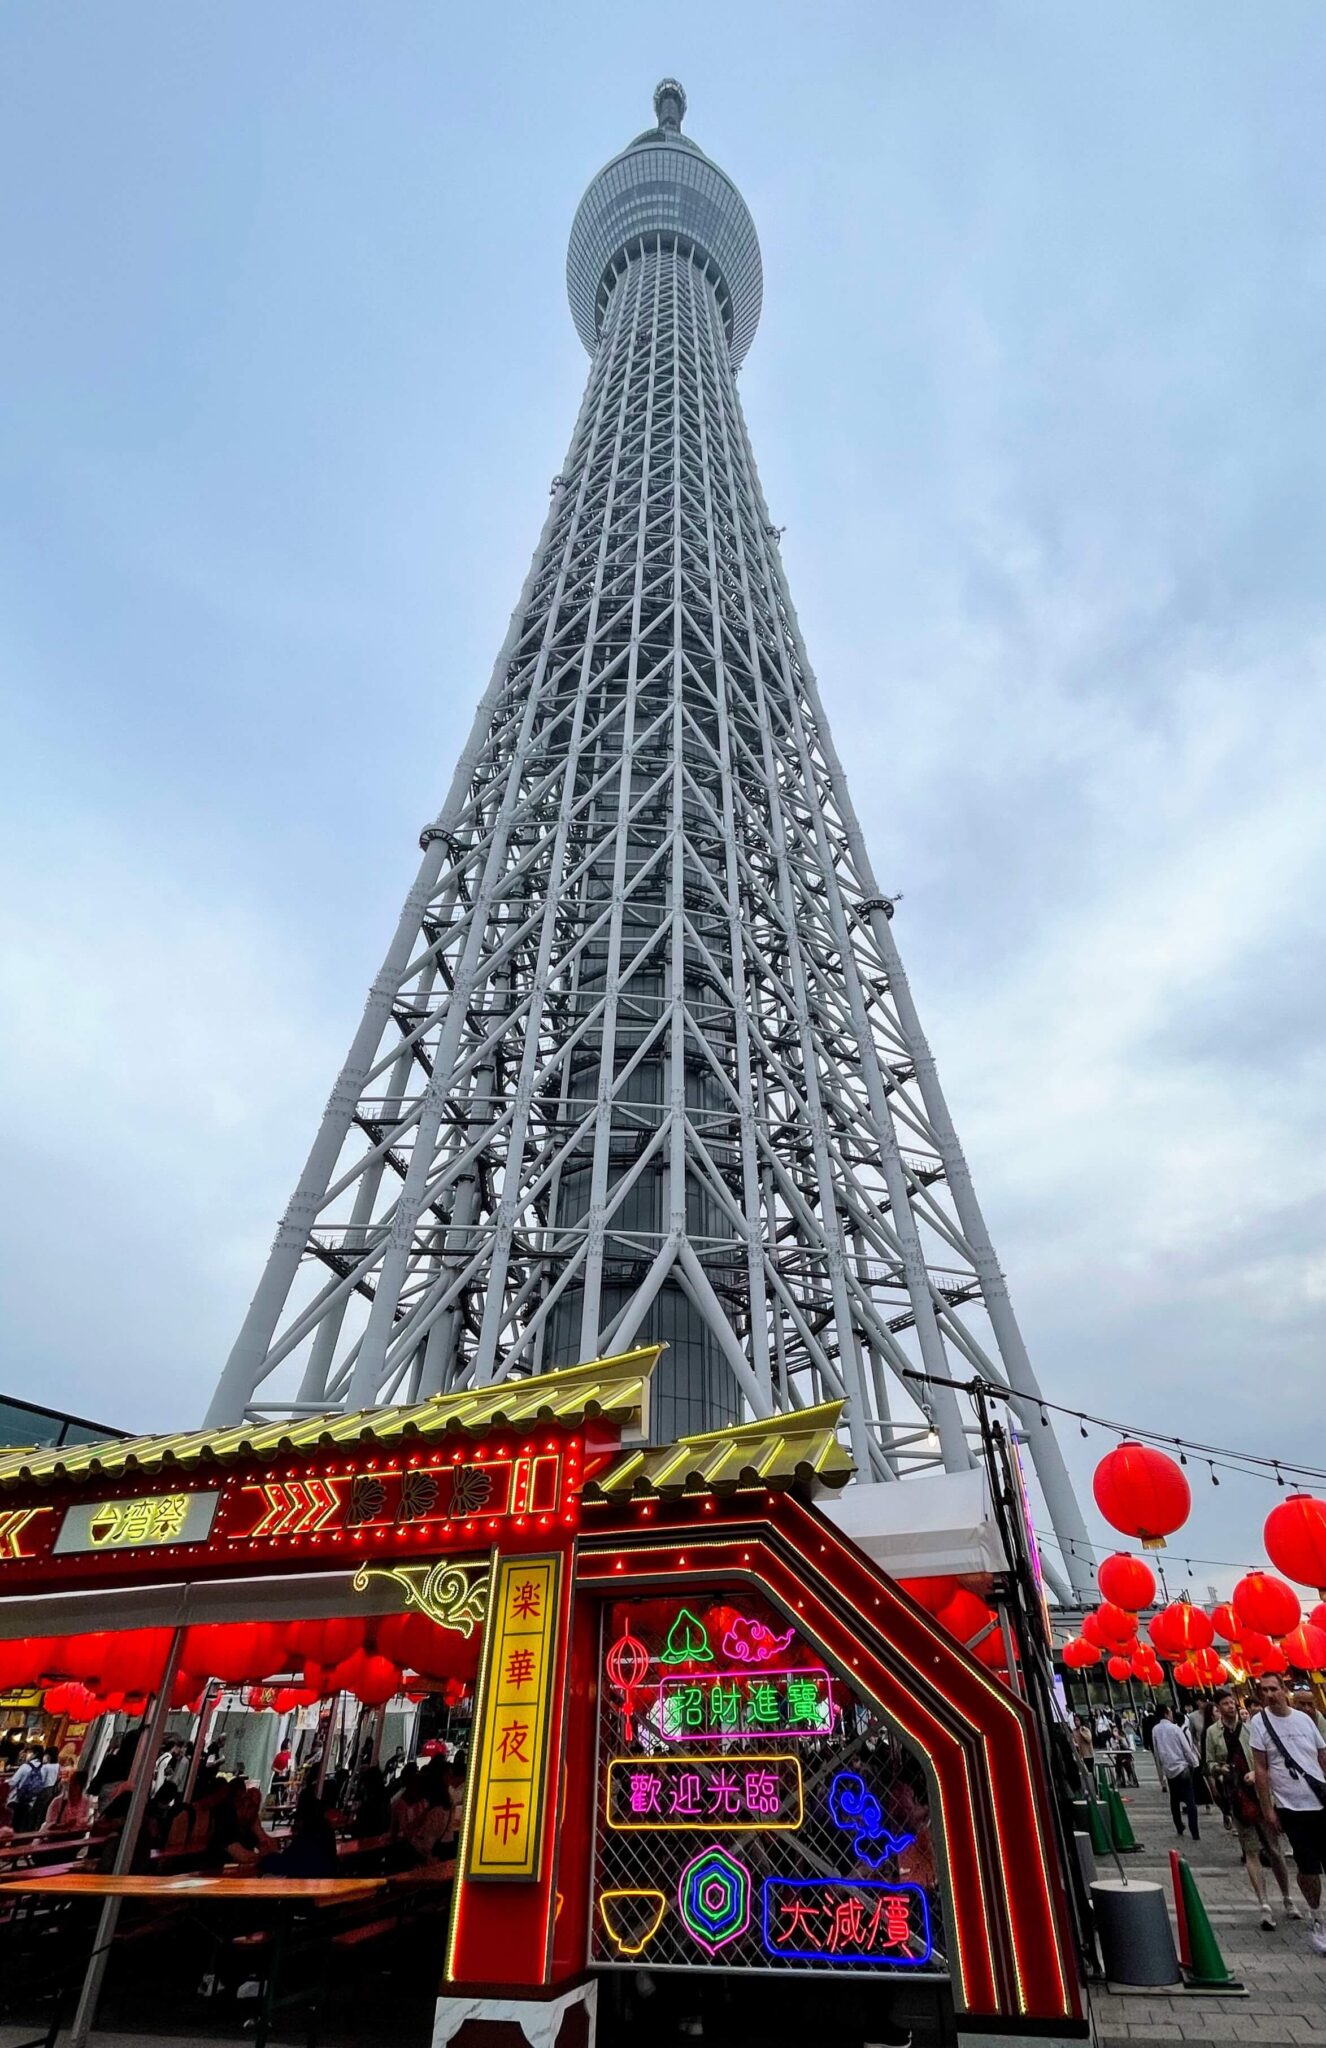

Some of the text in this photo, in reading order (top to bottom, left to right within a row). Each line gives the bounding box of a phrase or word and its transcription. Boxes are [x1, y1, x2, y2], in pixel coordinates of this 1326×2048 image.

[91, 1494, 187, 1542] 台湾祭
[493, 1580, 541, 1846] 楽華夜市
[671, 1679, 823, 1726] 招財進寶
[629, 1768, 780, 1814] 歡迎光臨
[777, 1892, 915, 1960] 大減價
